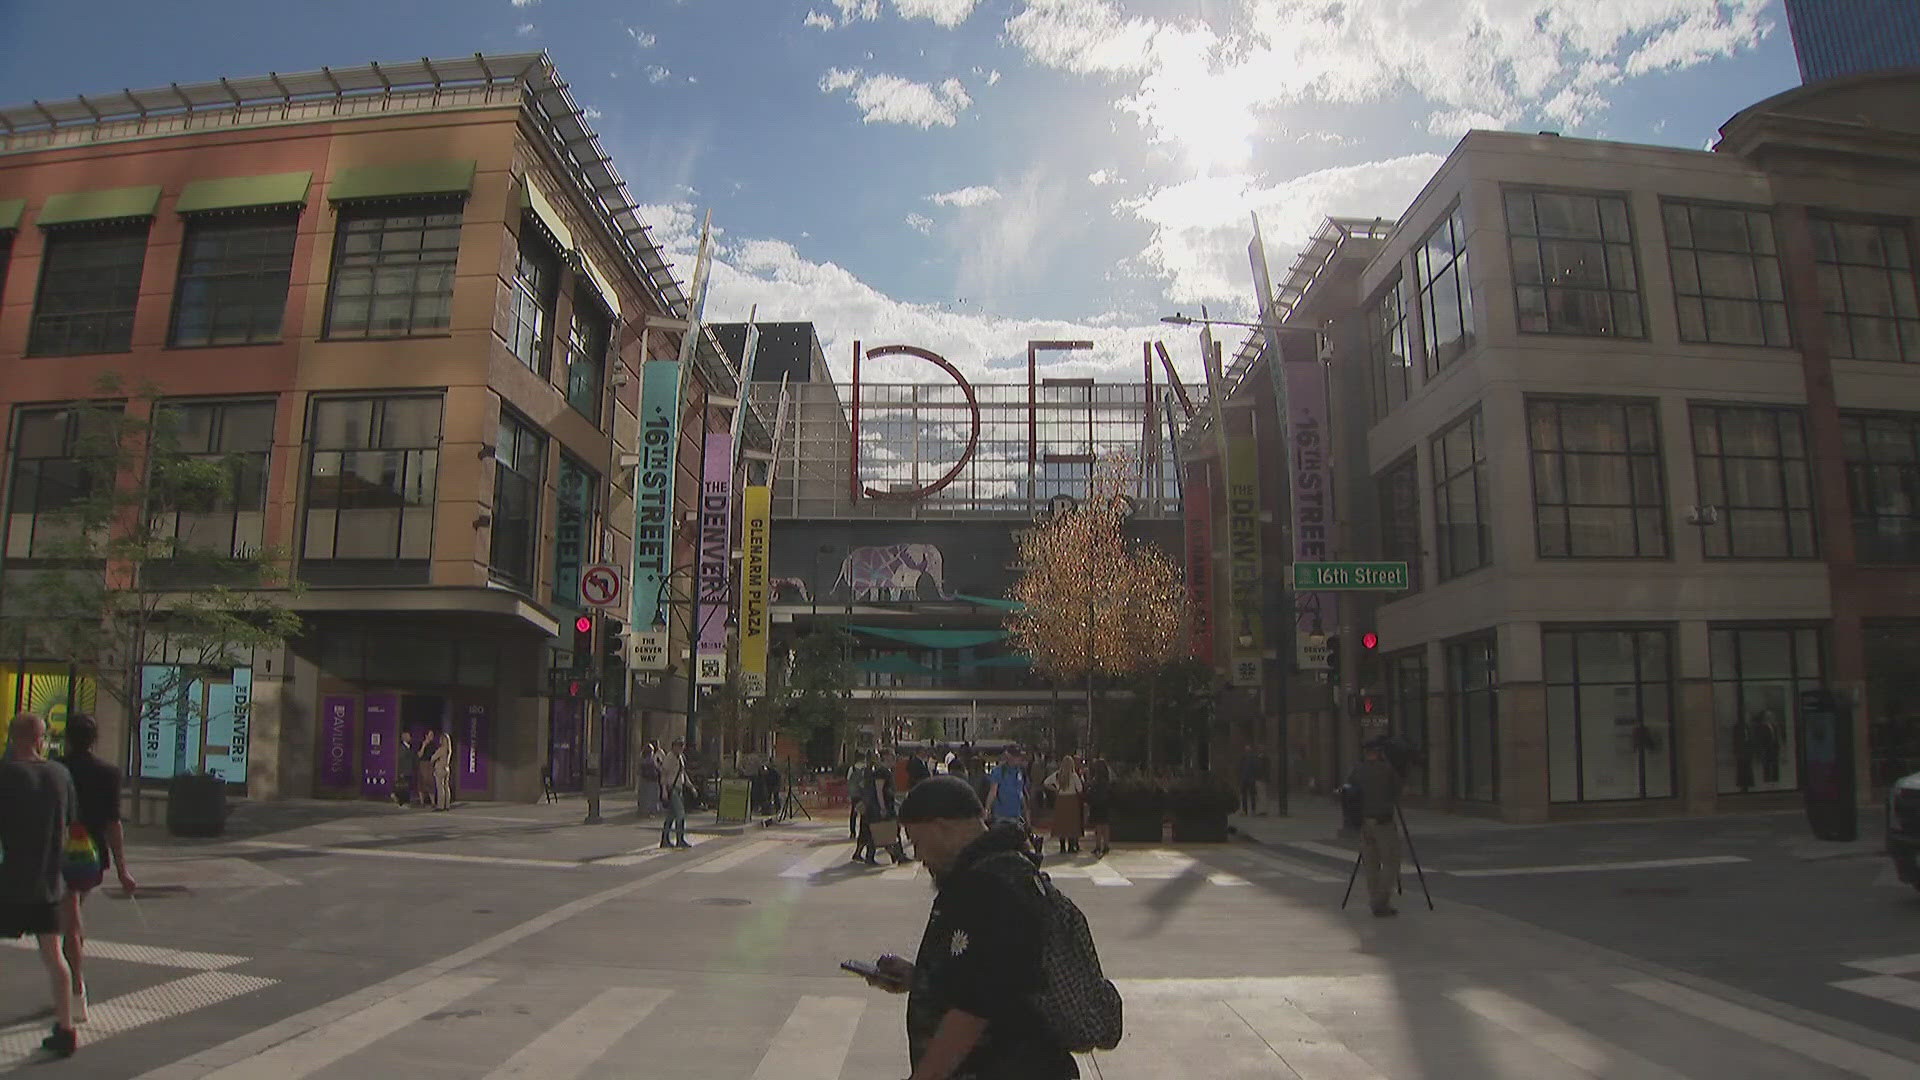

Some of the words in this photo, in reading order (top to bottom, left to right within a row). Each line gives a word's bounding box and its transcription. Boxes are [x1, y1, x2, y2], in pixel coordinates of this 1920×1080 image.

[705, 481, 727, 493] THE
[1232, 485, 1254, 496] THE
[1297, 473, 1326, 562] STREE
[638, 473, 667, 578] STREET
[702, 496, 726, 592] DENVER
[750, 518, 763, 586] GLENARM
[1317, 567, 1349, 584] 16th
[1355, 567, 1402, 584] Street
[747, 589, 761, 637] PLAZA
[233, 694, 247, 755] DENVER
